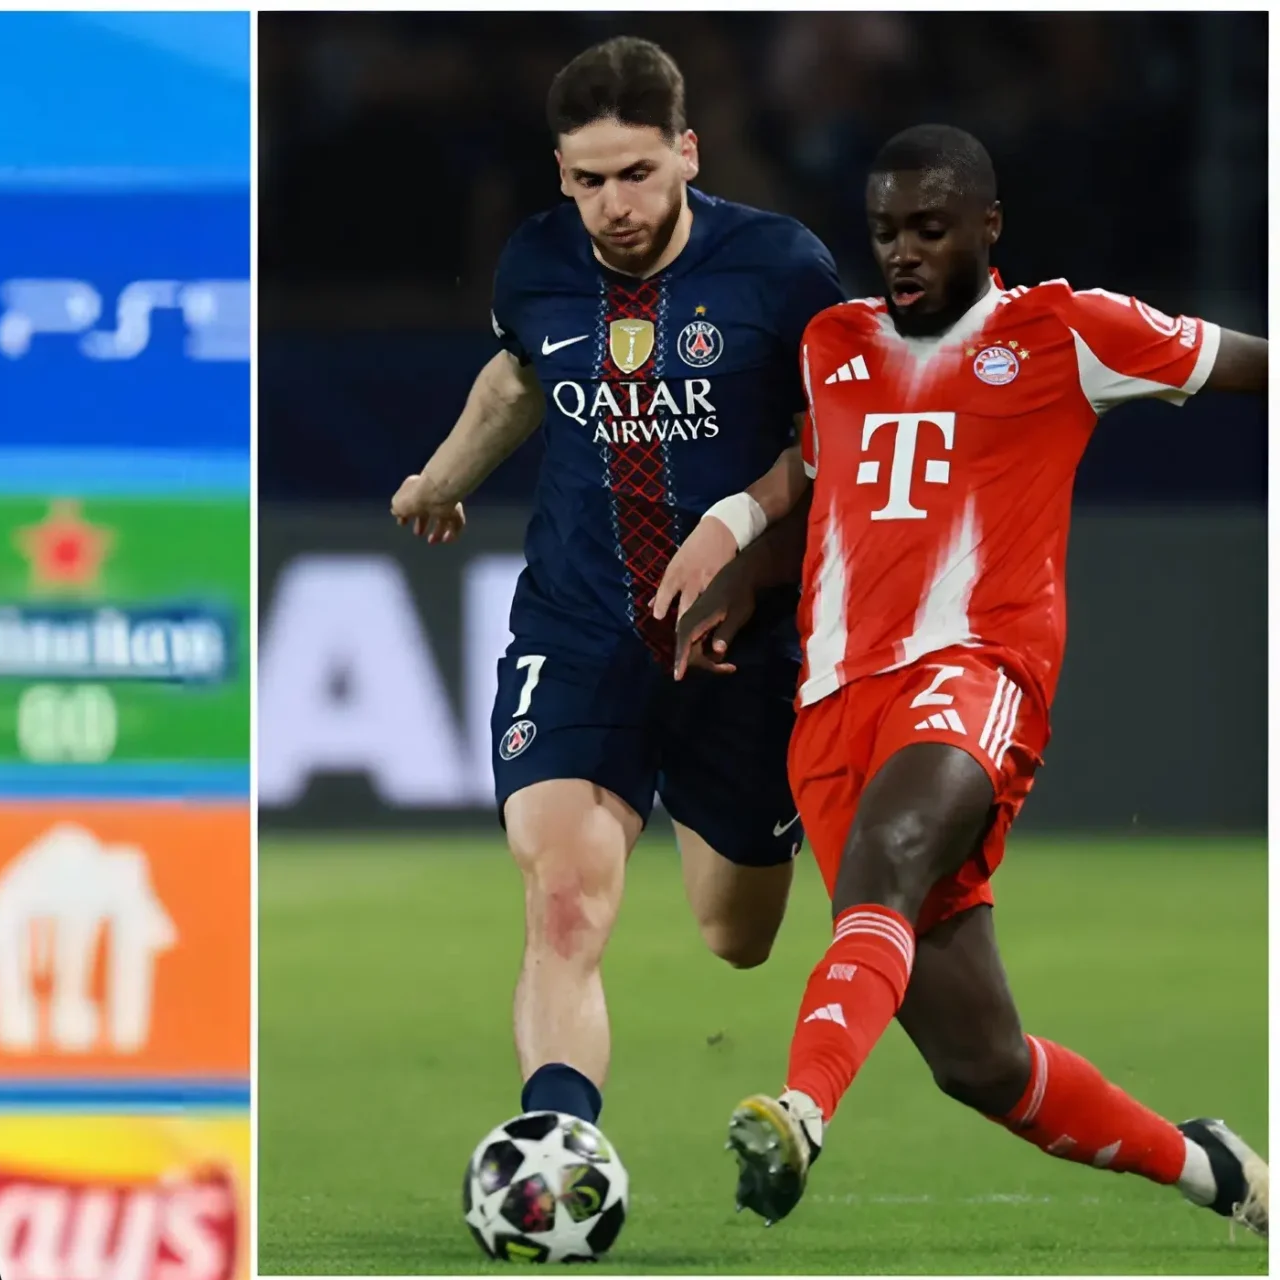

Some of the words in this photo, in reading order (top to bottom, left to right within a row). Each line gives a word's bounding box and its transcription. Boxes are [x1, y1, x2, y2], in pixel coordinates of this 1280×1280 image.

[553, 378, 717, 426] QATAR
[592, 414, 720, 443] AIRWAYS
[855, 411, 956, 520] T
[512, 654, 547, 718] 7
